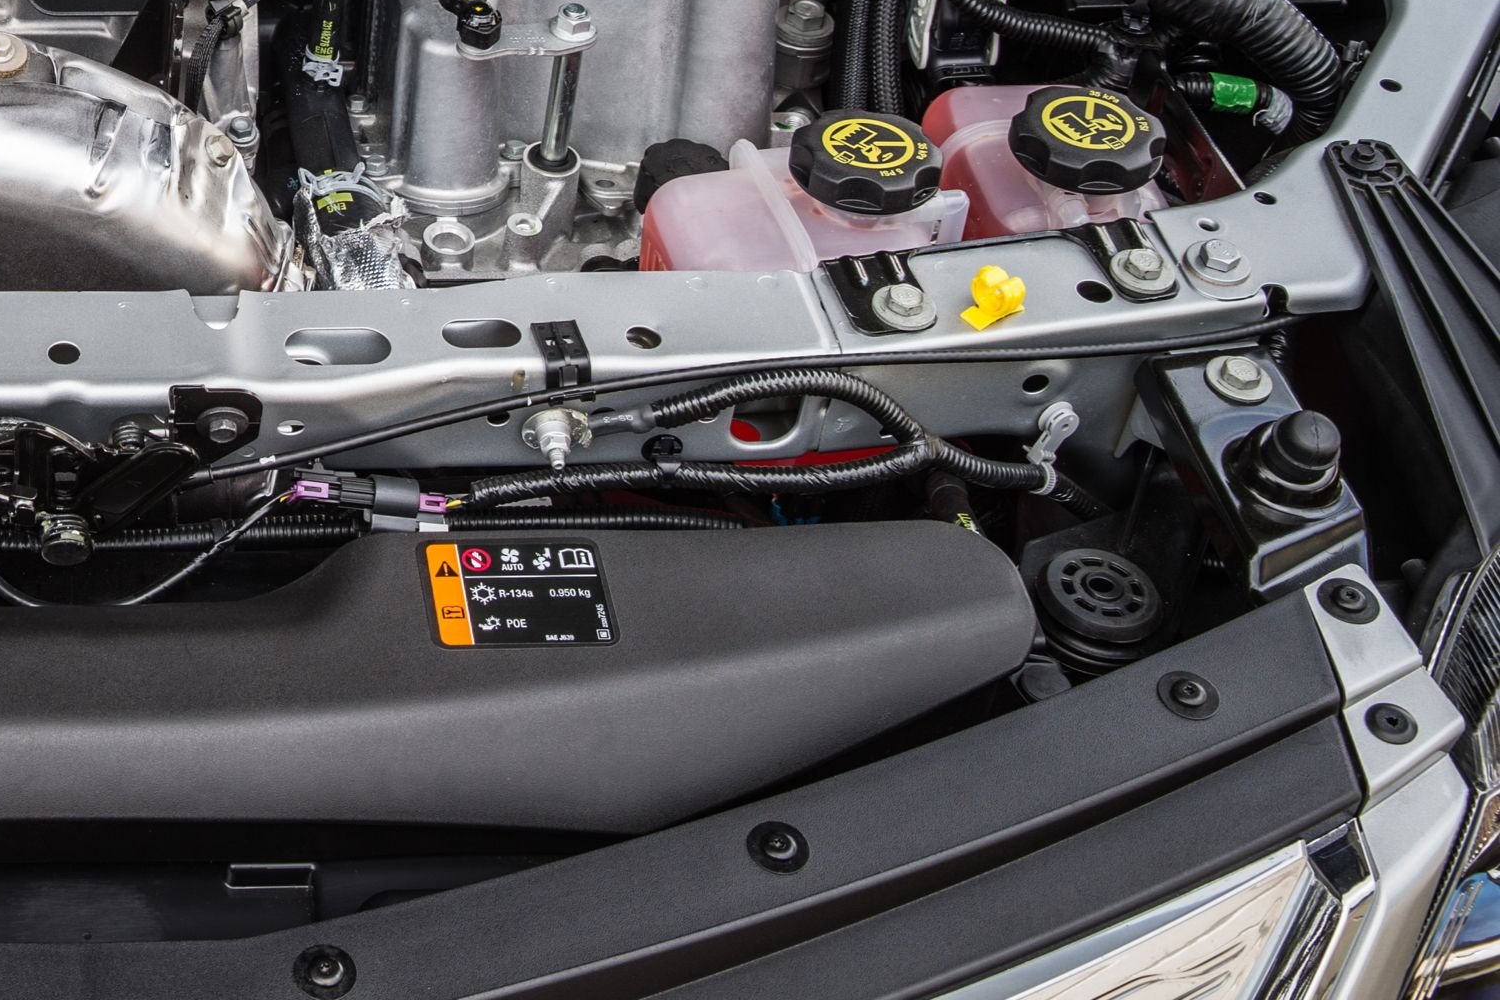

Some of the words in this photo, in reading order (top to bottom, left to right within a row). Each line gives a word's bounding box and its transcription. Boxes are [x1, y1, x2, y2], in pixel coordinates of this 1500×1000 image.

[315, 45, 334, 54] ENG
[1102, 93, 1120, 104] kPa
[1138, 121, 1150, 132] PSI
[916, 142, 928, 150] 35
[915, 150, 929, 161] kPa
[879, 169, 897, 177] PSI
[326, 202, 347, 213] ENG
[501, 563, 524, 571] AUTO
[498, 588, 534, 598] R-134a
[549, 588, 576, 598] 0.950
[578, 588, 591, 599] kg
[506, 618, 528, 628] POE
